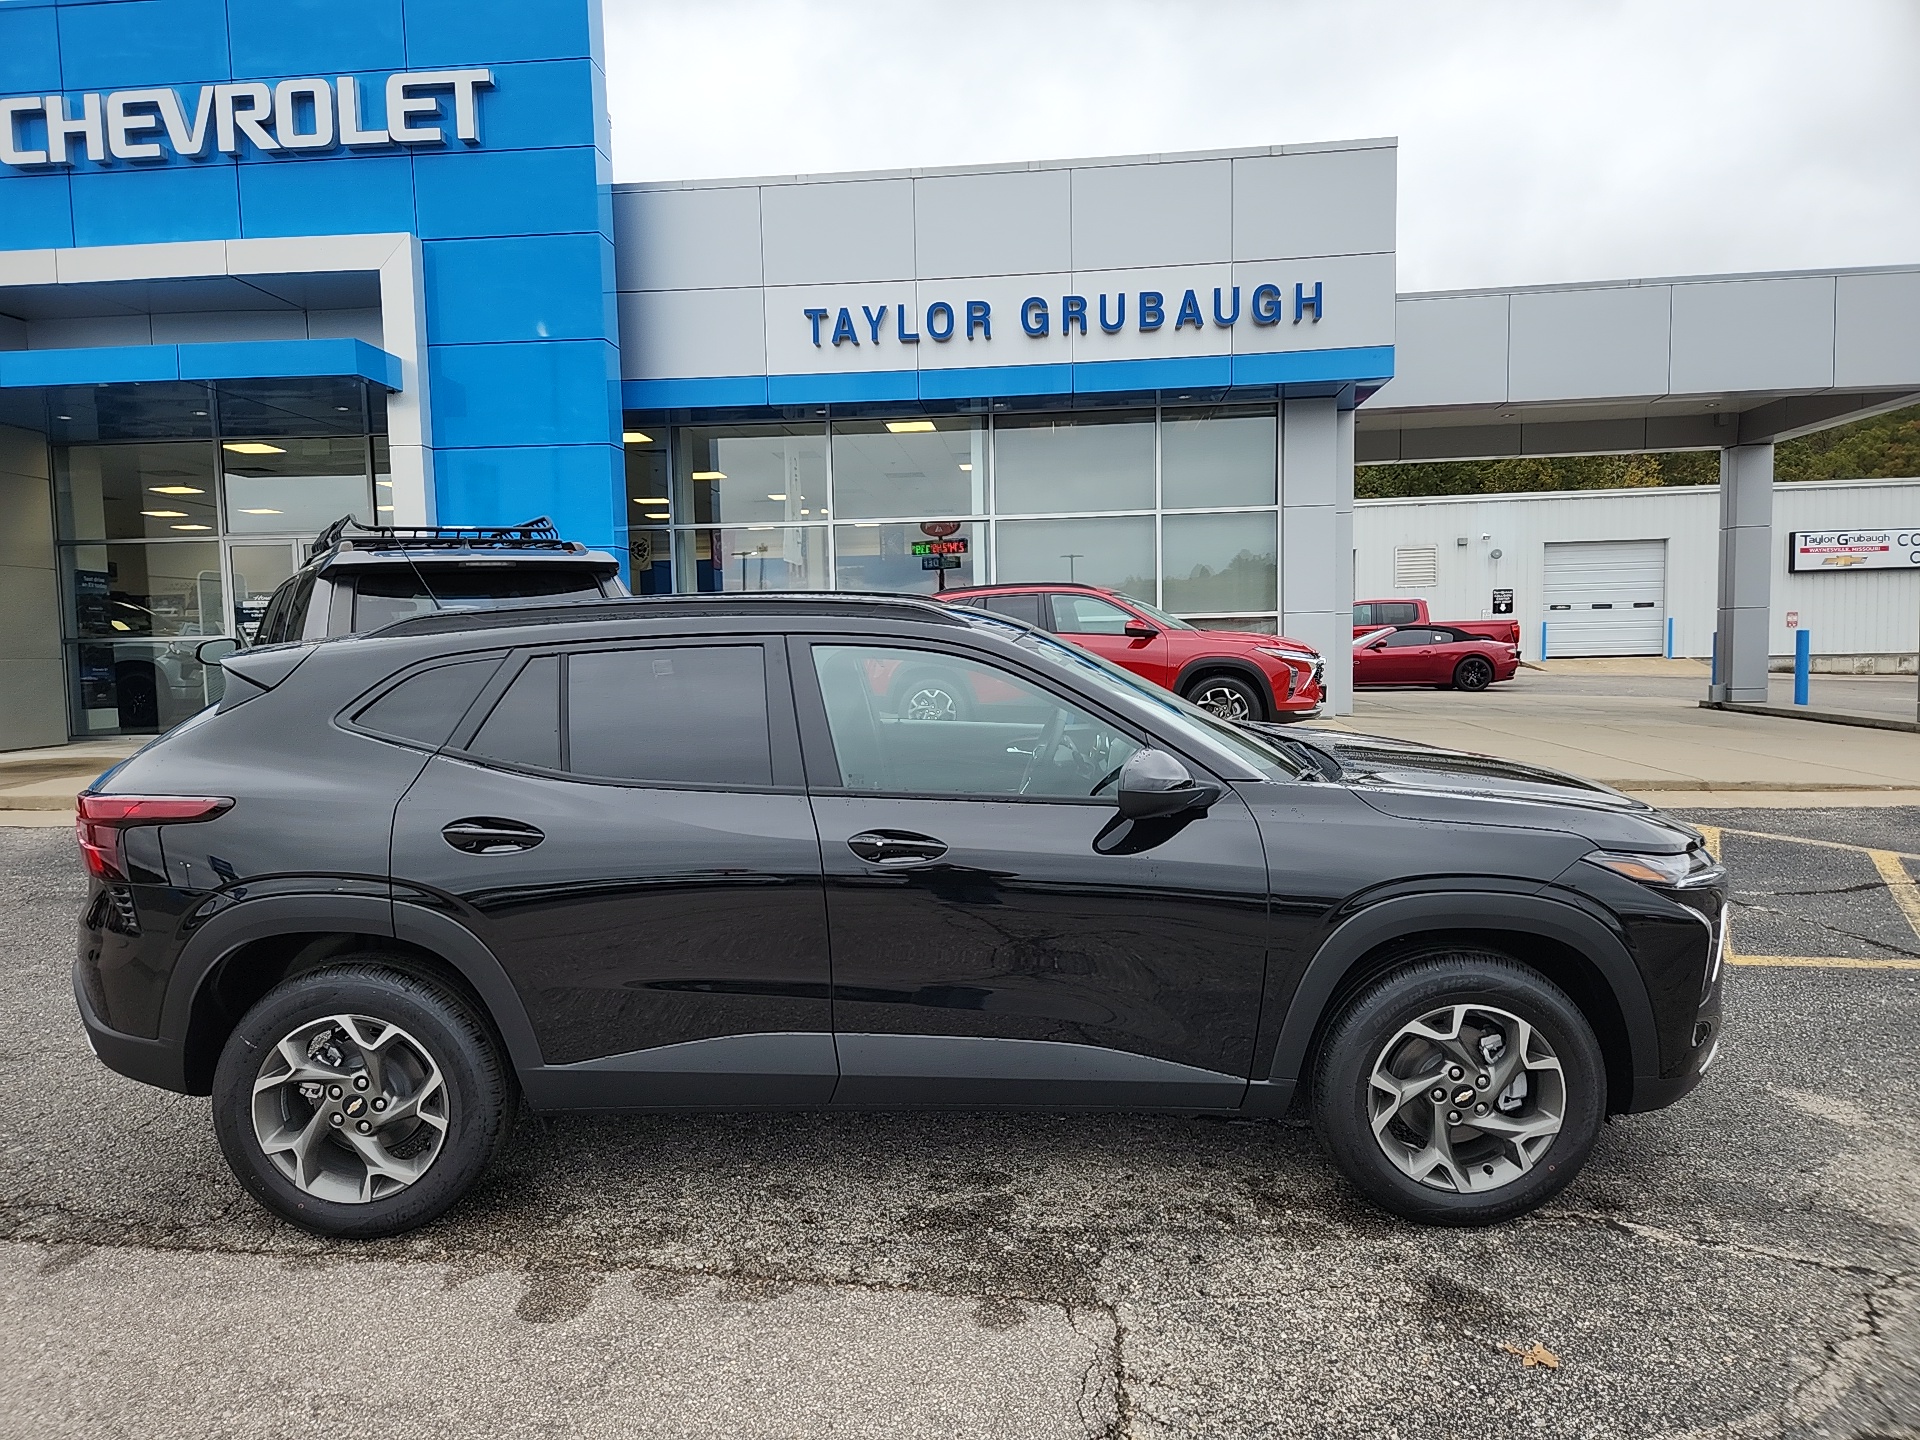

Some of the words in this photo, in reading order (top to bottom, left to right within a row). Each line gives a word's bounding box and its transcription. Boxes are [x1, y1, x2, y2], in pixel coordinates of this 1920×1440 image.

[0, 69, 492, 165] CHEVROLET
[803, 300, 992, 346] TAYLOR
[1020, 281, 1323, 337] GRUBAUGH
[1799, 534, 1835, 546] Taylor
[1837, 533, 1890, 545] Grubaugh
